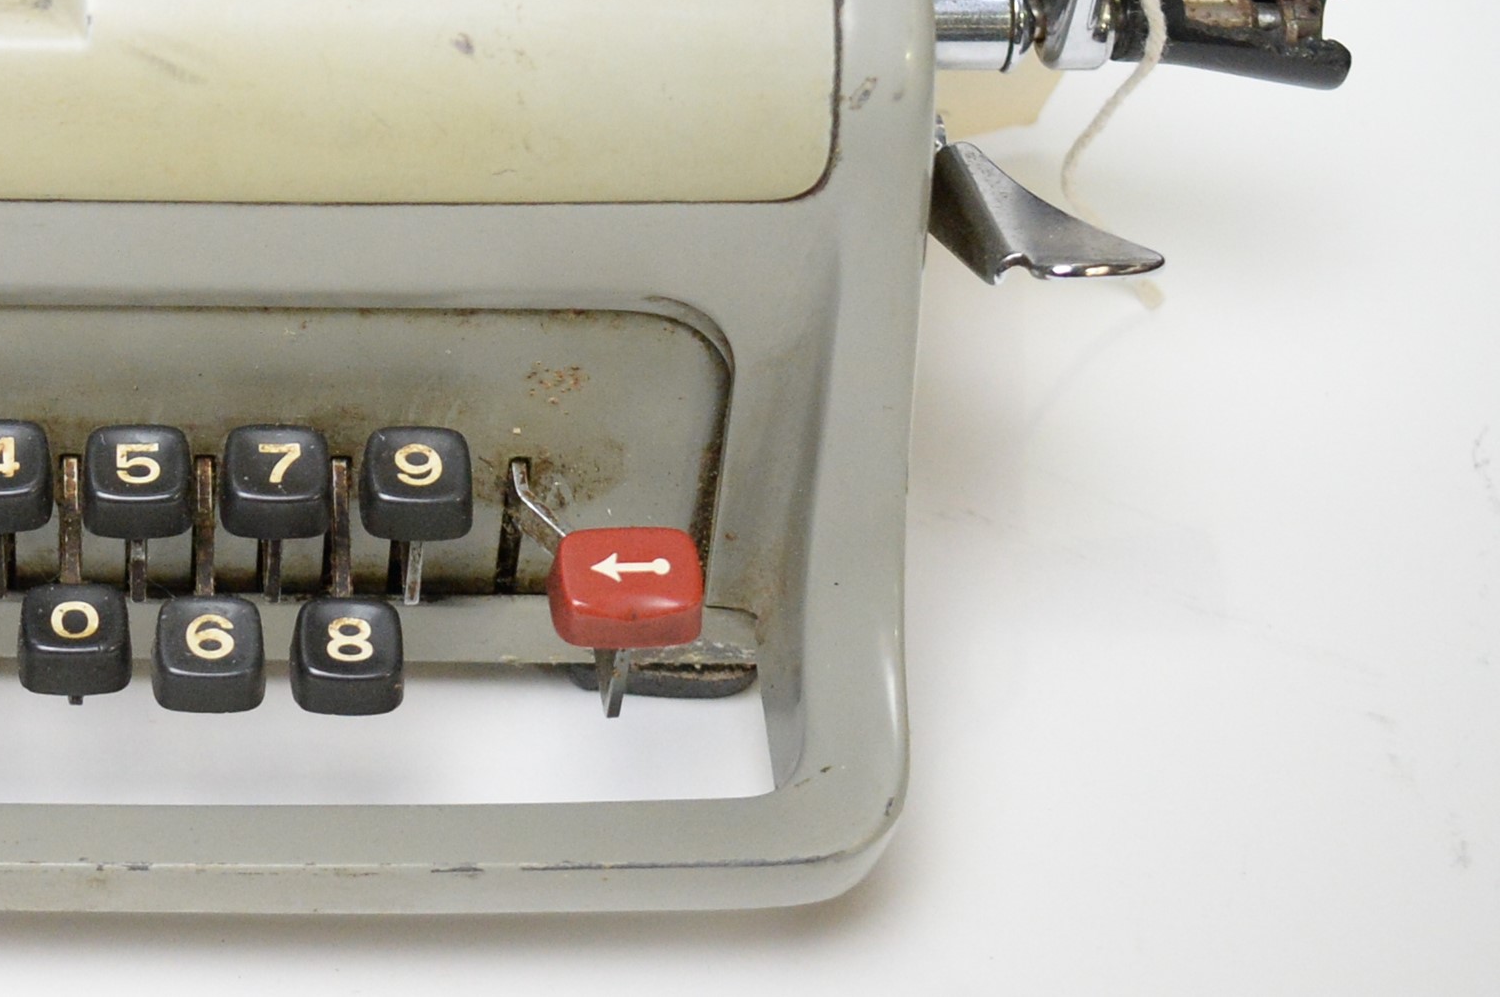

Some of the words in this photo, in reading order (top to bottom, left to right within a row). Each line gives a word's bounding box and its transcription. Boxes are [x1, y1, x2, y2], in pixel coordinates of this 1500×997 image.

[116, 442, 161, 485] 5
[258, 443, 302, 484] 7
[394, 443, 443, 486] 9
[50, 600, 100, 639] 0
[185, 614, 235, 660] 6
[326, 616, 374, 662] 8
